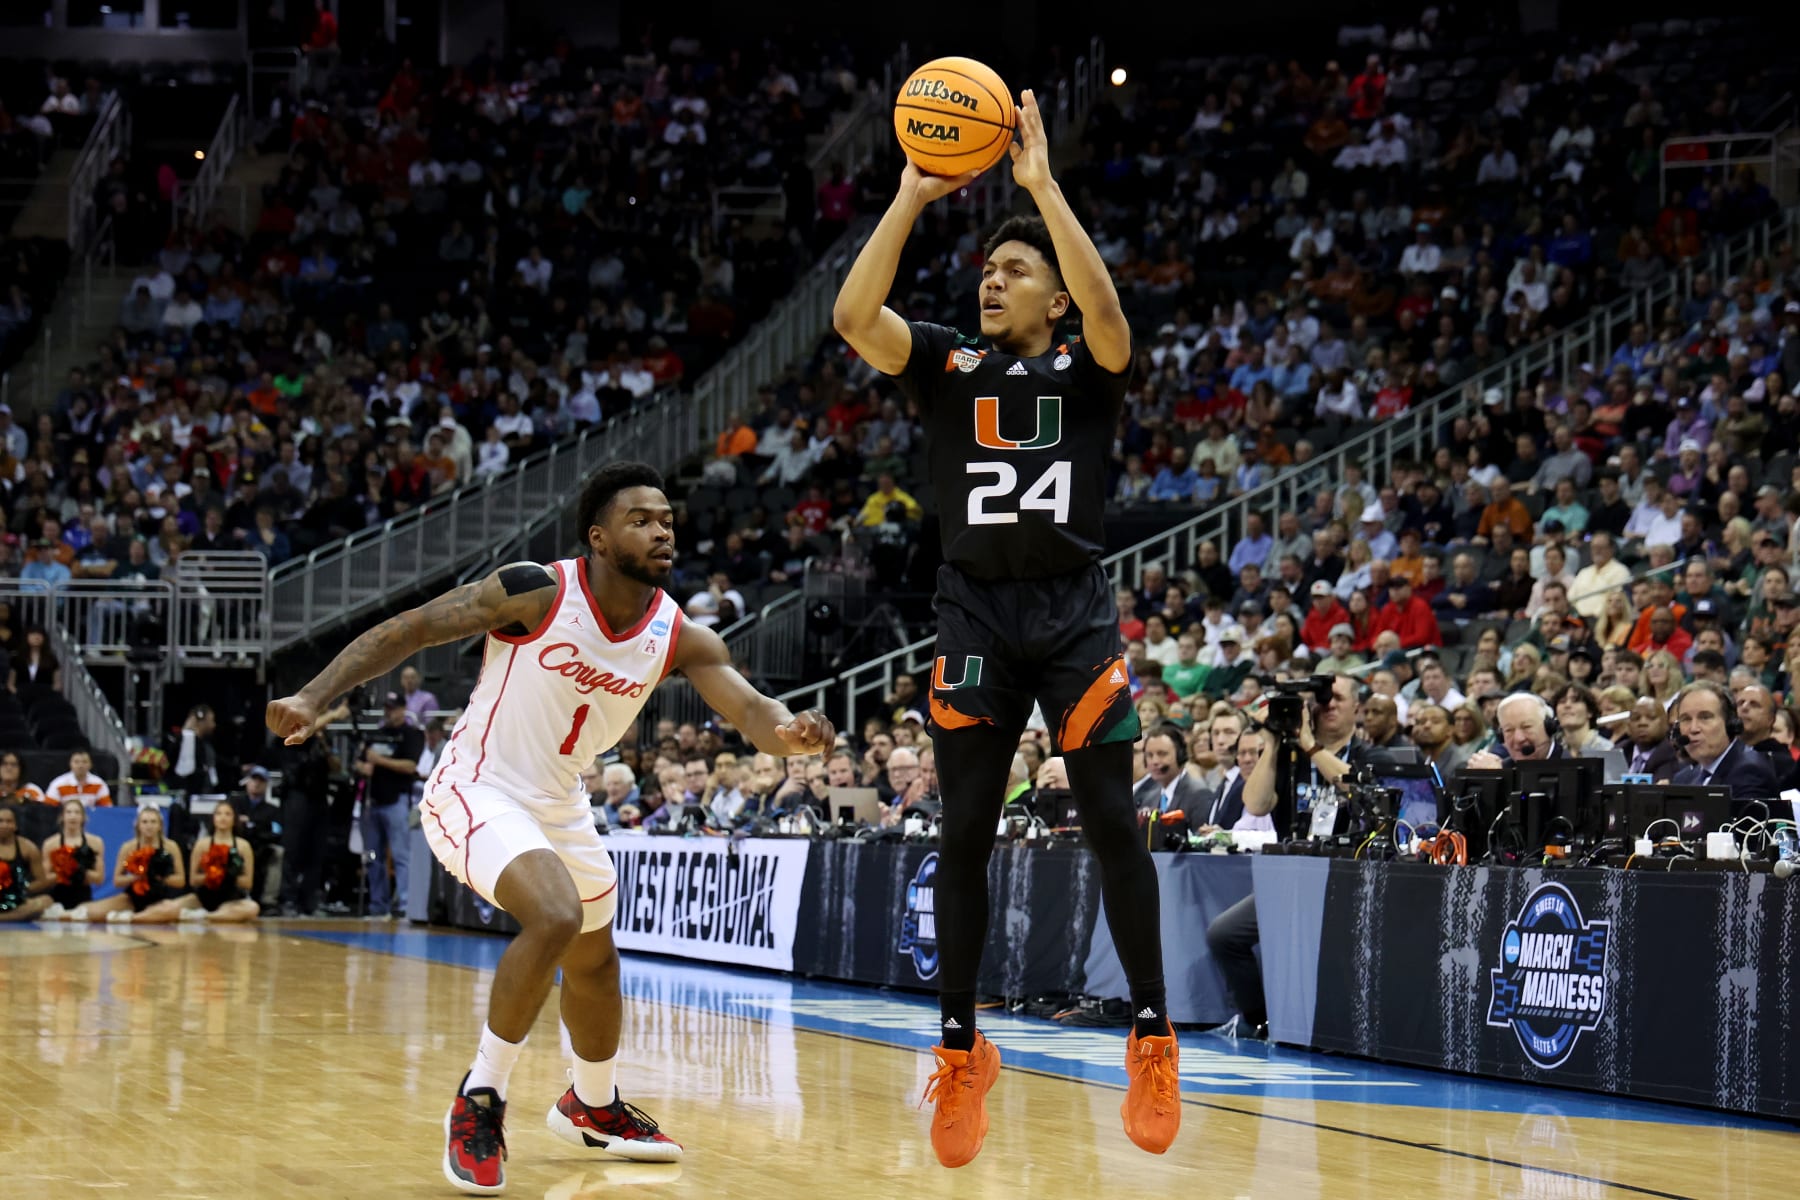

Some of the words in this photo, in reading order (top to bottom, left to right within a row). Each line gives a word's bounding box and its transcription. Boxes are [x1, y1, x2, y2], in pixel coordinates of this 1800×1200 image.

[907, 79, 978, 112] Wilson
[906, 118, 960, 142] NCAA
[974, 396, 1062, 450] U
[966, 461, 1072, 525] 24
[538, 642, 648, 698] Cougars
[559, 704, 590, 755] 1
[607, 851, 672, 935] WEST
[673, 851, 779, 949] REGIONAL
[1535, 897, 1555, 916] SWEET
[1518, 932, 1574, 970] MARCH
[1521, 970, 1603, 1011] MADNESS
[1533, 1036, 1551, 1054] ELITE
